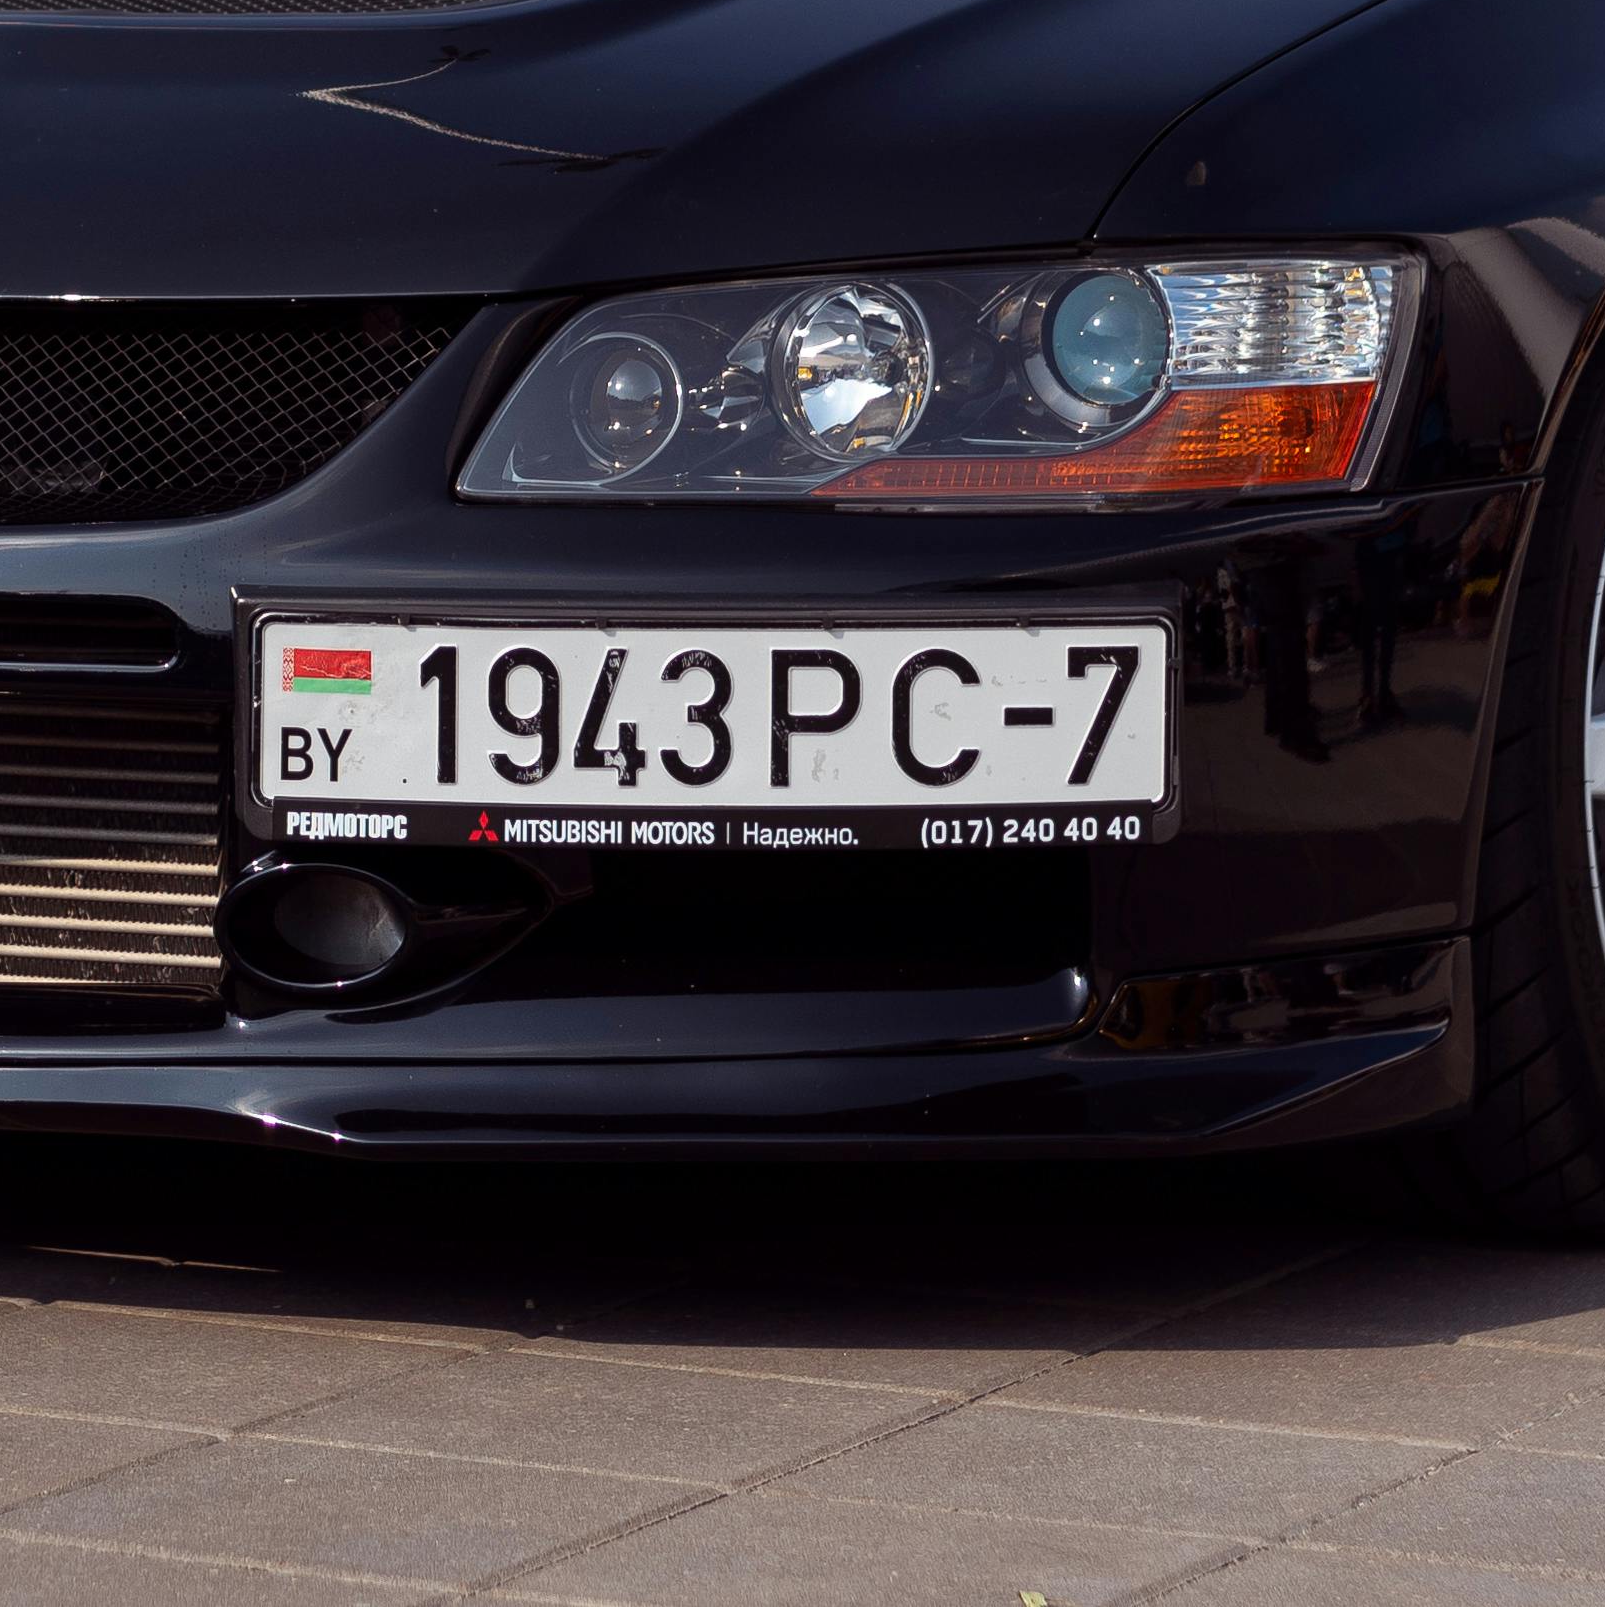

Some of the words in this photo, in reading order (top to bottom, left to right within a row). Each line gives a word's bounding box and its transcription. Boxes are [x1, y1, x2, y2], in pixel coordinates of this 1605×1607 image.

[281, 727, 352, 781] BY
[287, 812, 407, 840] РЕДМОТОРС
[505, 819, 622, 844] MITSUBISHI
[631, 821, 715, 844] MOTORS
[744, 822, 858, 848] Надежно.
[922, 817, 992, 848] (017)
[1003, 819, 1054, 843] 240
[1064, 817, 1097, 841] 40
[1107, 816, 1140, 840] 40
